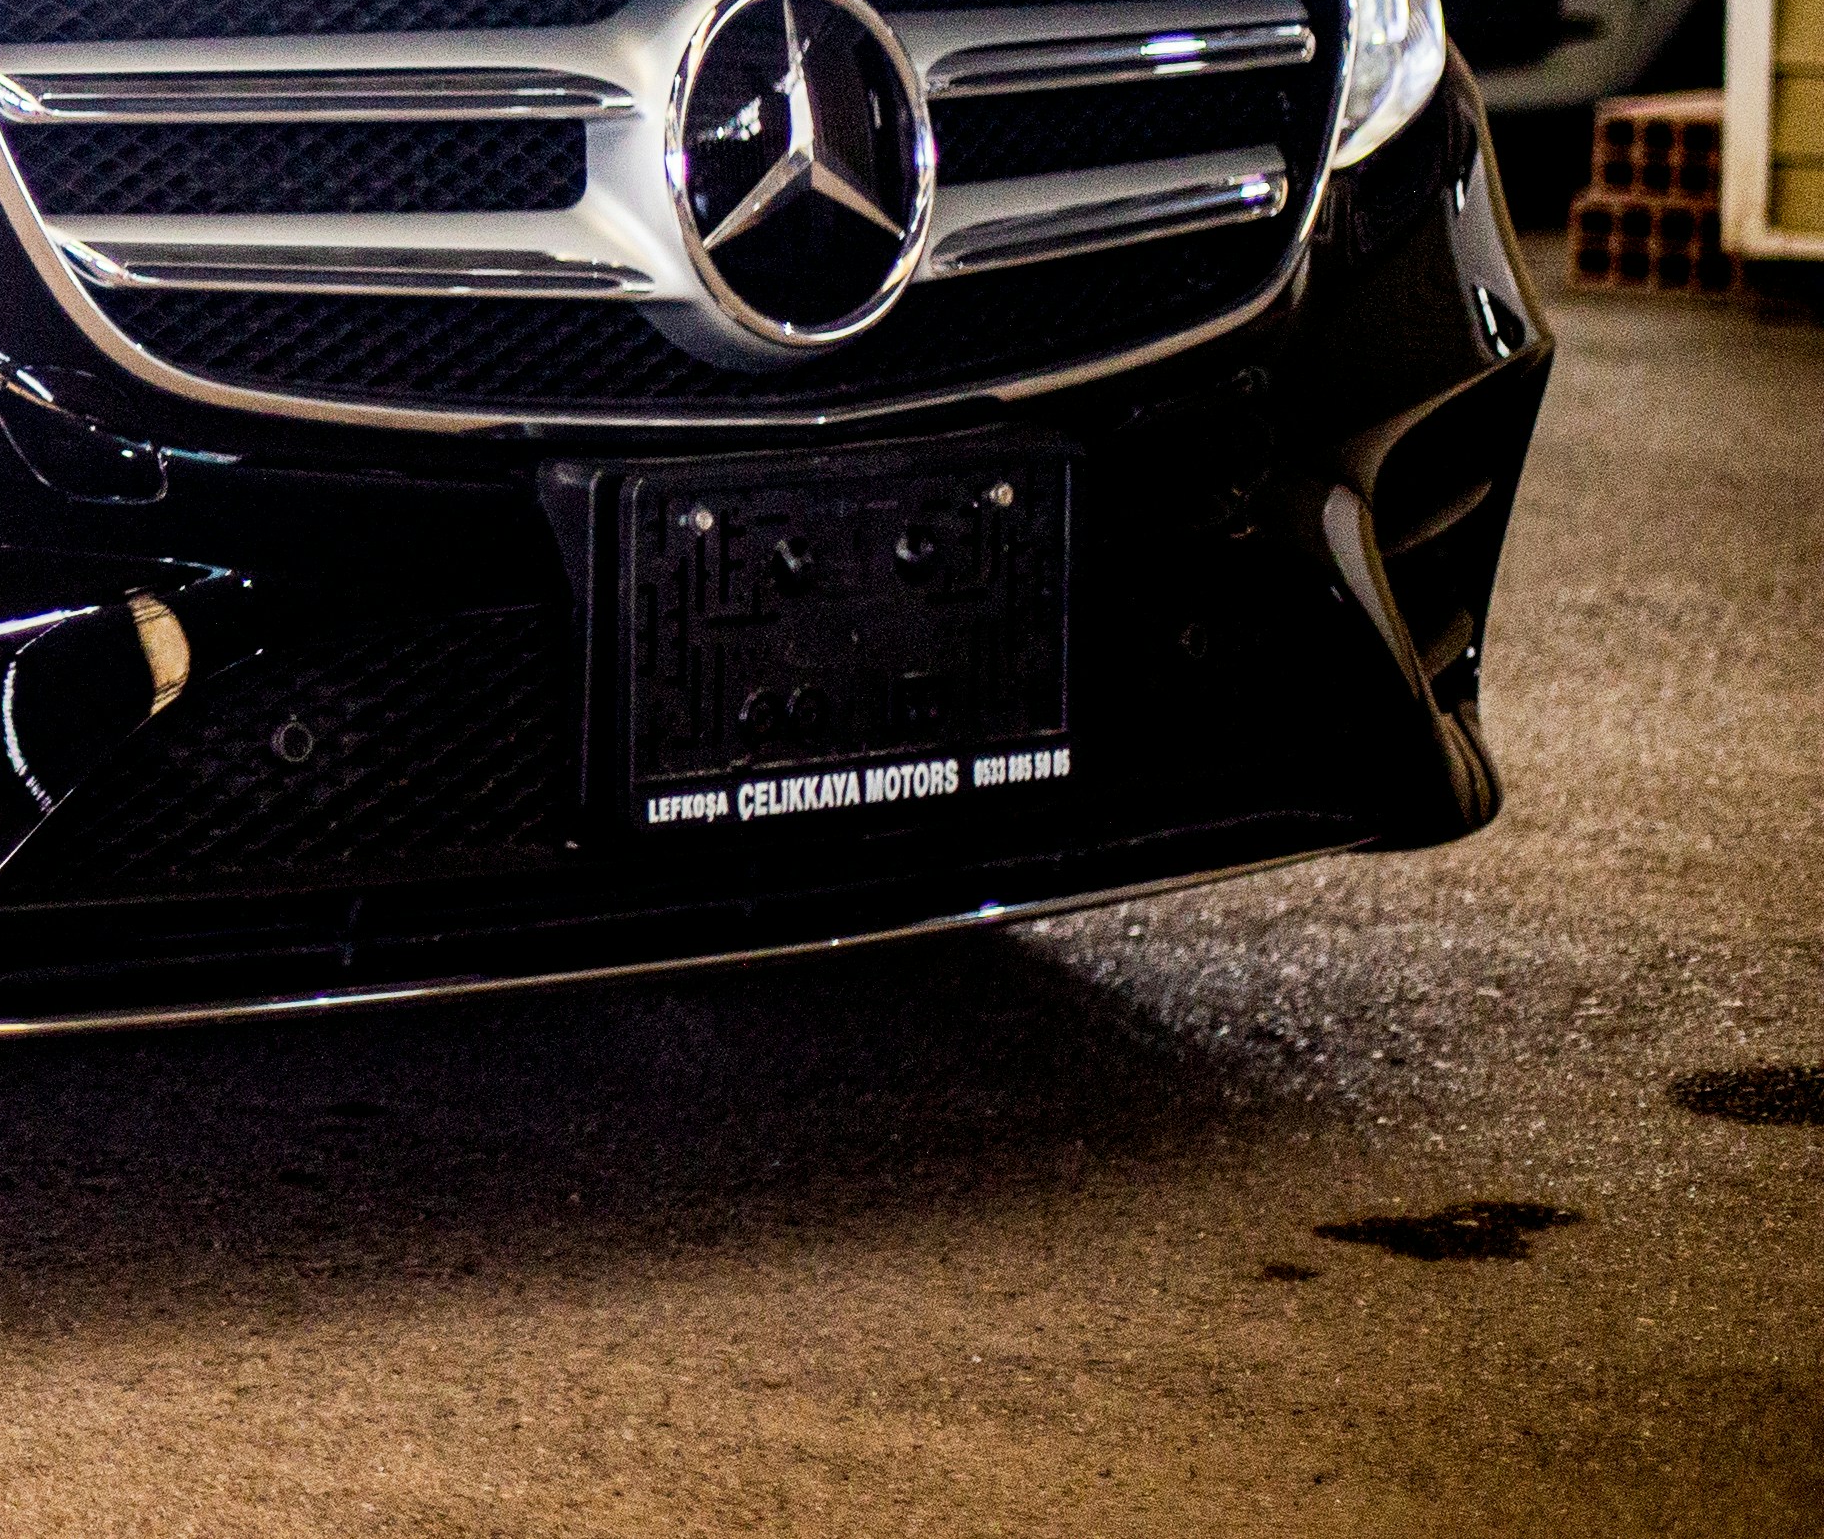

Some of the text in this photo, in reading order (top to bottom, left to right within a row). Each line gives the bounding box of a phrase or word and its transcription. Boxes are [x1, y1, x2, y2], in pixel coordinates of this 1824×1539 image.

[648, 791, 729, 823] LEFKOŞA
[865, 759, 959, 803] MOTORS
[973, 757, 1006, 788] 0533
